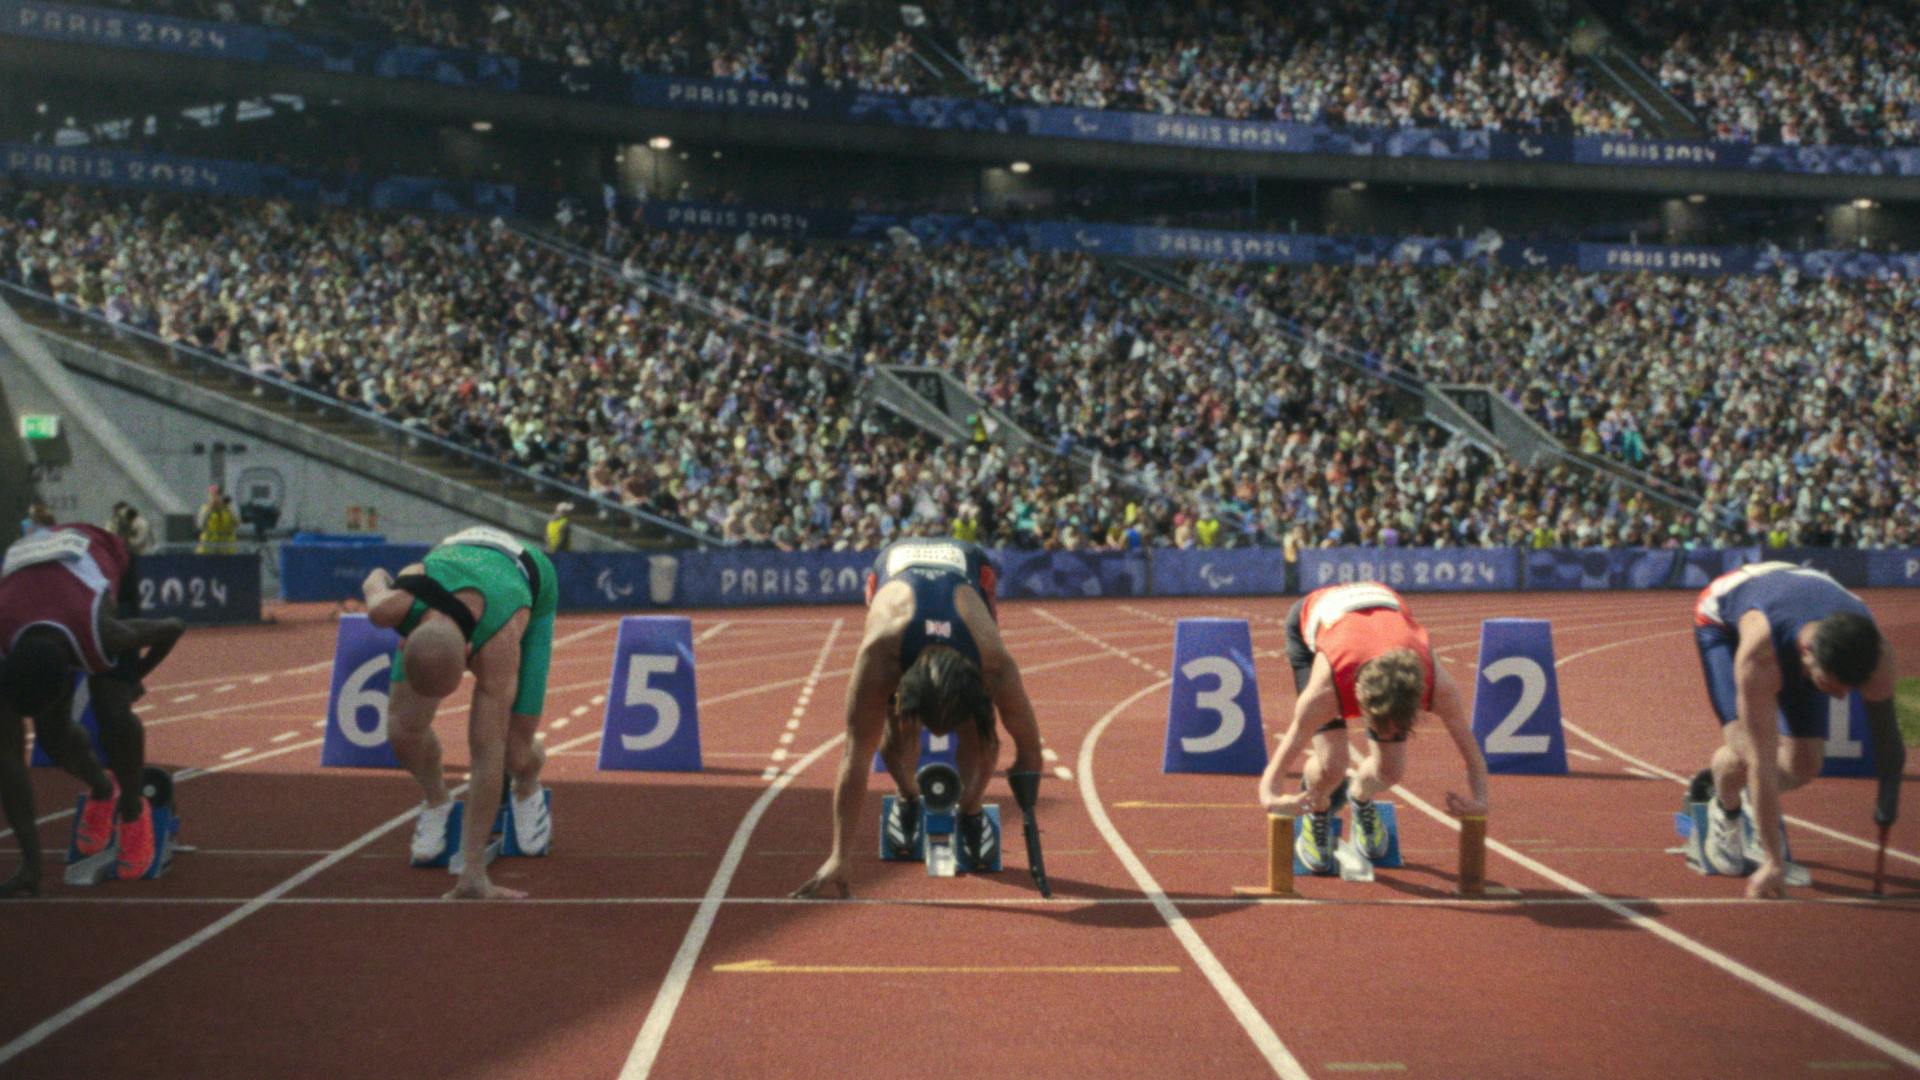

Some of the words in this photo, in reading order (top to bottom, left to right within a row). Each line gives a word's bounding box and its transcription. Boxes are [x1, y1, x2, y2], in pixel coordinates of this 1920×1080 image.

[20, 8, 122, 38] PARIS
[136, 21, 225, 49] 2024
[669, 83, 738, 105] PARIS
[747, 89, 809, 110] 2024
[1156, 121, 1221, 142] PARIS
[1229, 127, 1287, 145] 2024
[1602, 142, 1659, 160] PARIS
[1665, 145, 1716, 162] 2024
[8, 152, 114, 179] PARIS
[128, 161, 218, 186] 2024
[667, 207, 736, 227] PARIS
[747, 212, 808, 230] 2024
[1160, 235, 1224, 255] PARIS
[1232, 238, 1290, 257] 2024
[1607, 249, 1664, 267] PARIS
[1670, 251, 1722, 269] 2024
[720, 568, 808, 595] PARIS
[1318, 562, 1405, 584] PARIS
[1414, 561, 1495, 584] 2024
[139, 578, 226, 609] 2024
[337, 652, 391, 748] 6
[620, 653, 680, 751] 5
[1181, 655, 1245, 754] 3
[1482, 656, 1551, 754] 2
[1823, 693, 1863, 758] 1
